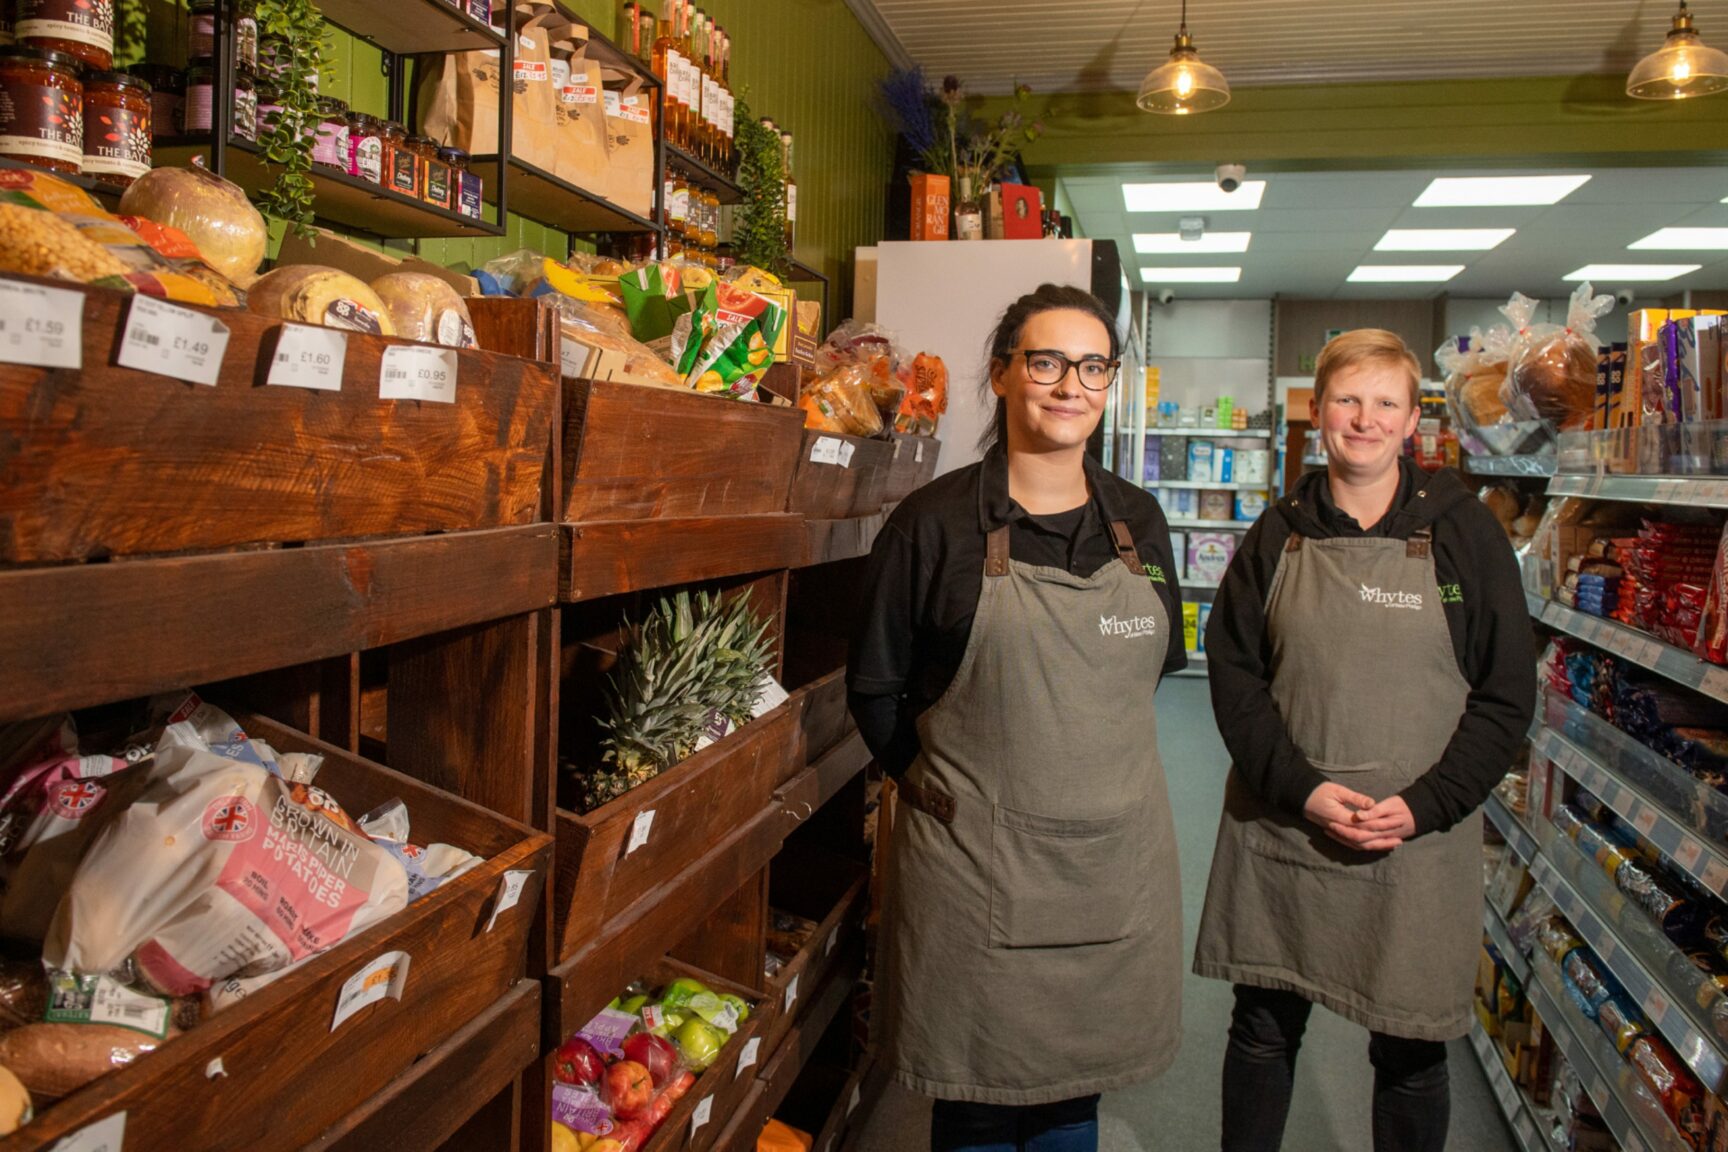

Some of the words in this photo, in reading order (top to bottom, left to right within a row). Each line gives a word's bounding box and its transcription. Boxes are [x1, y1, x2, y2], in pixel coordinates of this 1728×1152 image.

[66, 11, 90, 25] THE
[39, 128, 62, 141] THE
[97, 146, 120, 157] THE
[926, 194, 948, 206] GLEN
[926, 214, 945, 224] RAN
[726, 313, 744, 323] SALE
[25, 317, 64, 335] £1.59
[173, 336, 208, 356] £1.49
[300, 351, 331, 365] £1.60
[418, 368, 446, 381] £0.95
[276, 795, 340, 846] GROWN
[341, 839, 360, 862] IN
[270, 806, 354, 880] BRITAIN
[266, 825, 308, 863] MARIS
[309, 856, 346, 894] PIPER
[262, 837, 342, 908] POTATOES
[251, 871, 269, 890] BOIL
